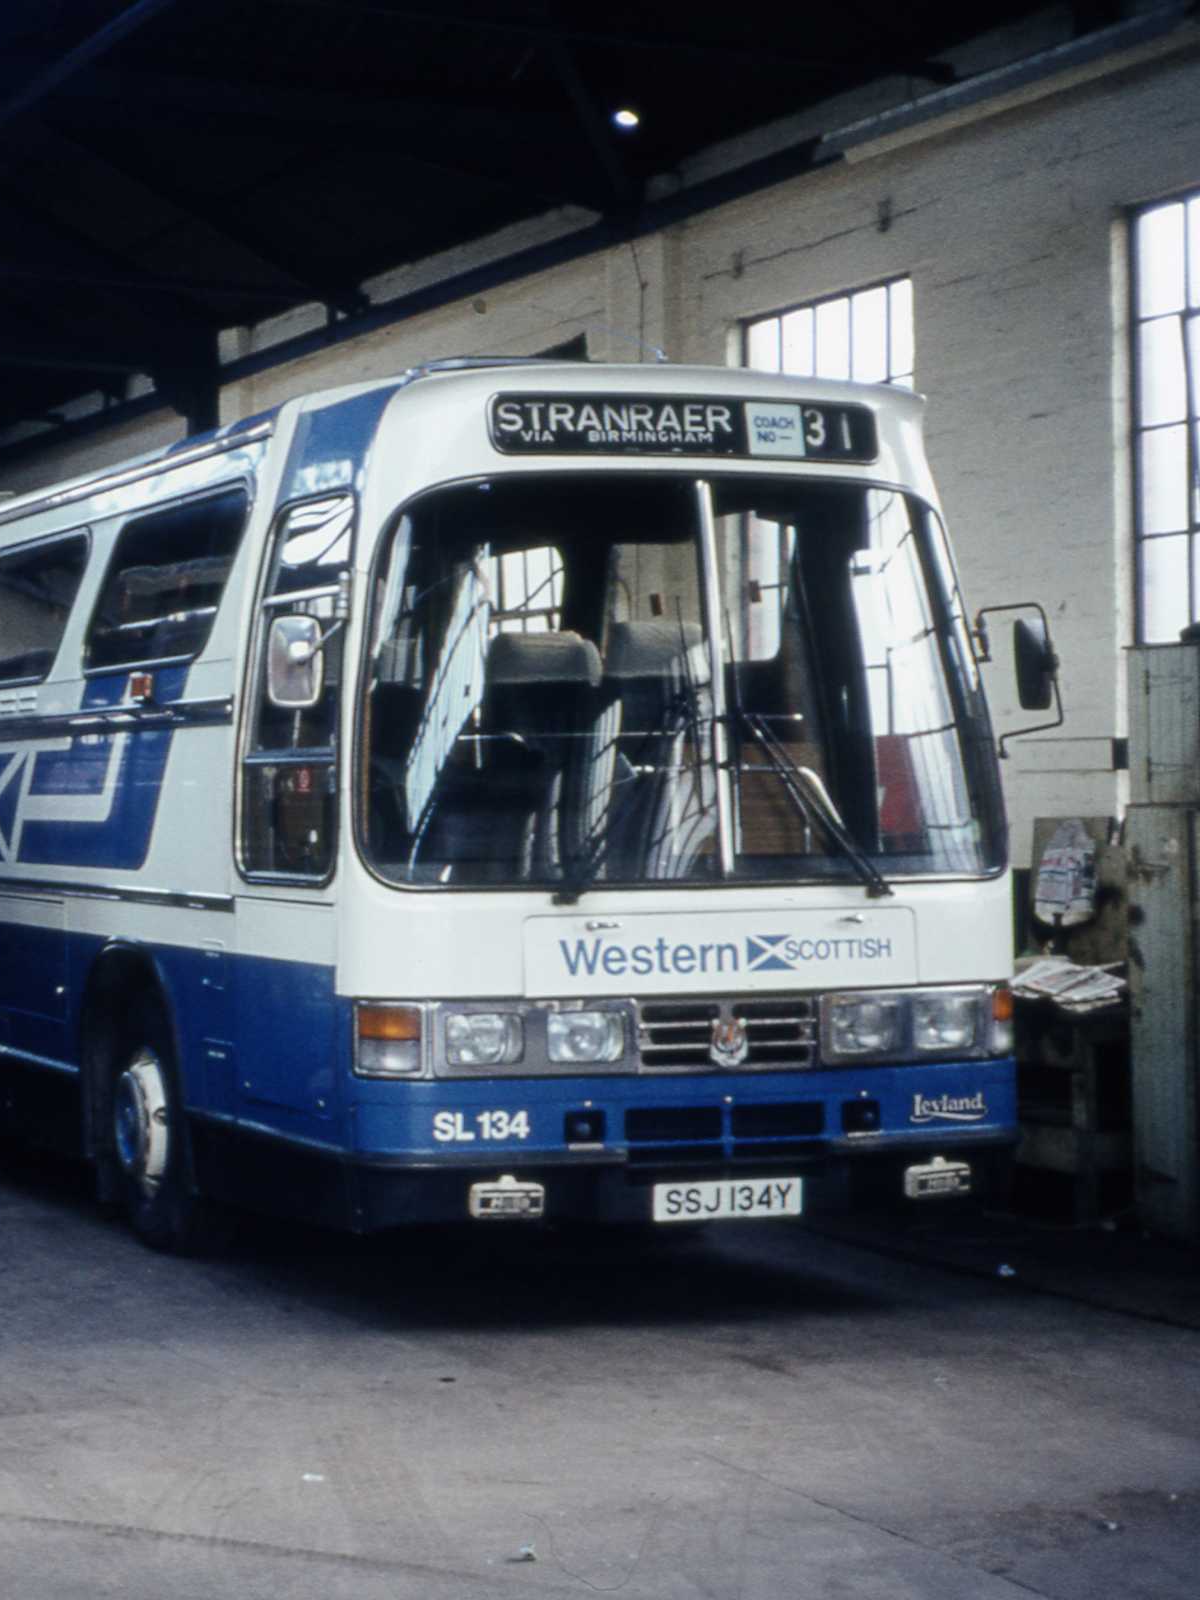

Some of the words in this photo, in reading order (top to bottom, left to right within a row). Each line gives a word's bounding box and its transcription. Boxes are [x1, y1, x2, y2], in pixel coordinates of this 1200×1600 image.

[500, 402, 732, 433] STRANRAER
[753, 415, 795, 429] COACH
[520, 430, 556, 443] VIA
[587, 430, 714, 444] BIRMINGHAM
[559, 938, 739, 976] Western
[784, 940, 892, 961] SCOTTISH
[910, 1092, 988, 1122] Leyland
[434, 1111, 475, 1141] SL
[478, 1109, 530, 1138] 134
